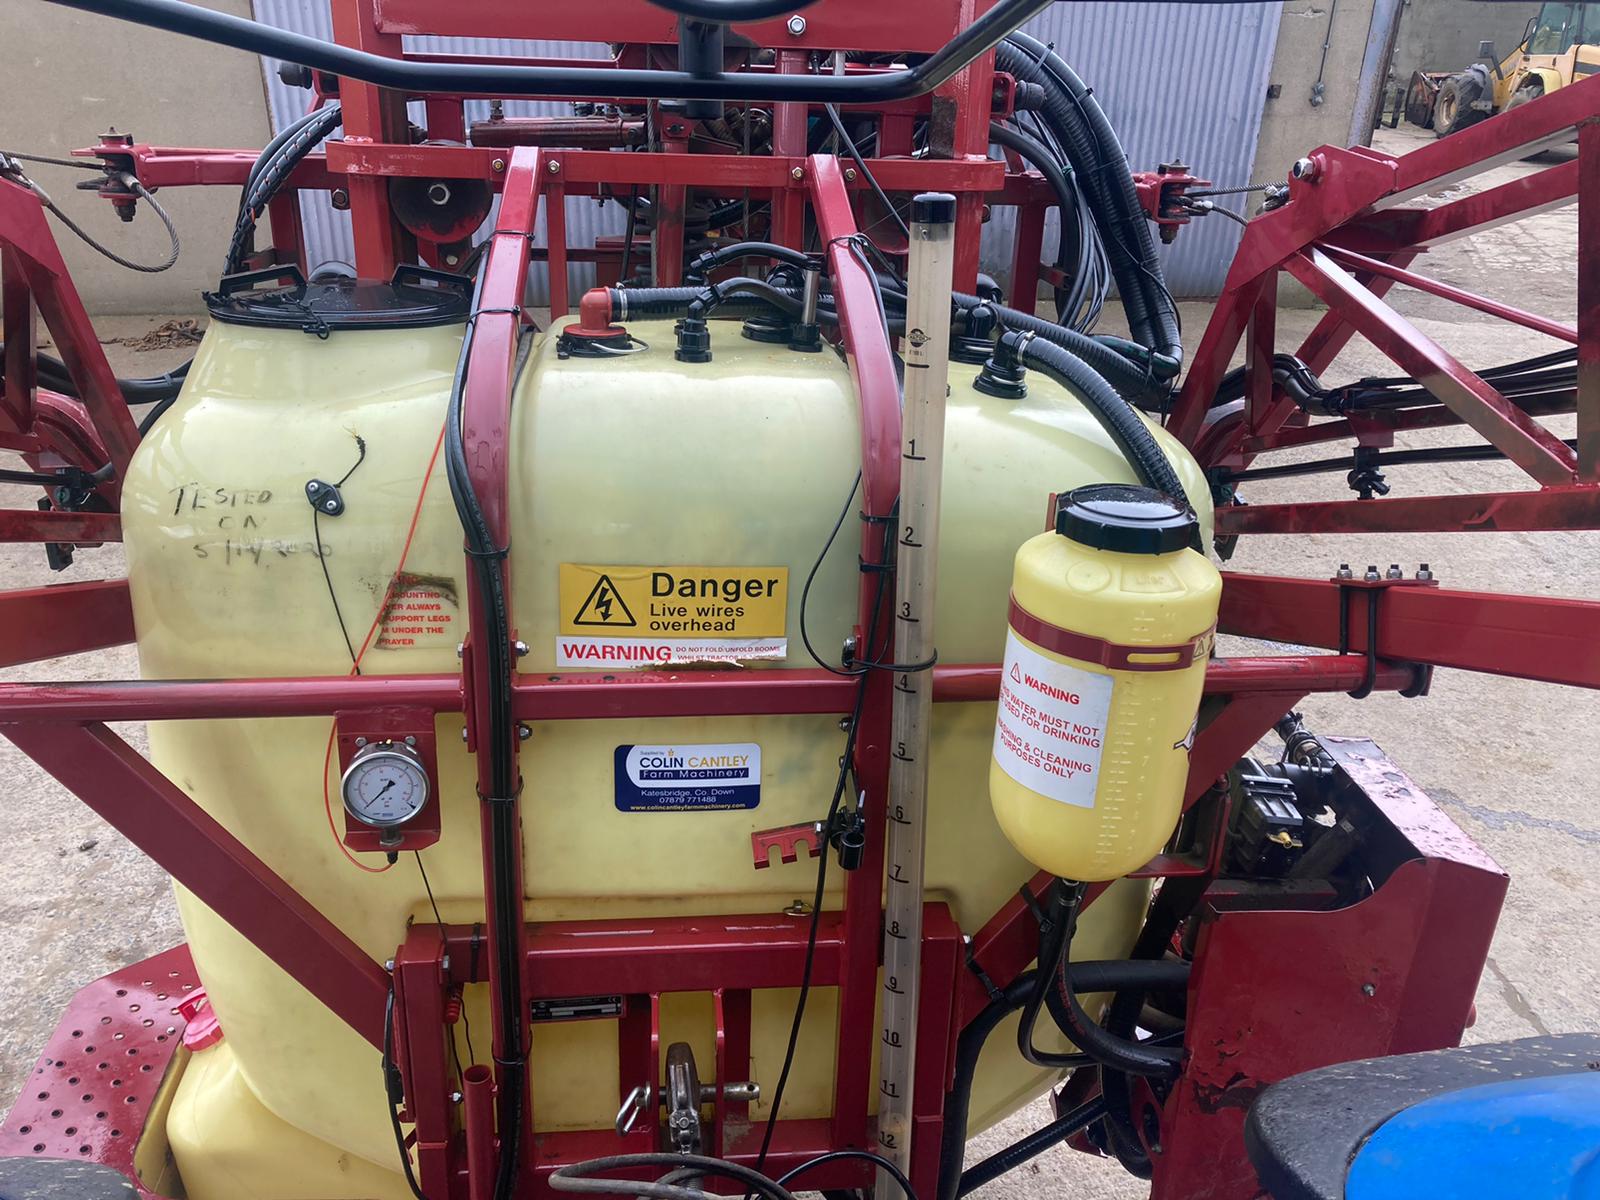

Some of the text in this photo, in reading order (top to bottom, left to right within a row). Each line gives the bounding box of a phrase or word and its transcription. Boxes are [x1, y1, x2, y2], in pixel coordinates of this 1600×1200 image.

[908, 438, 915, 455] 1
[905, 526, 913, 542] 2
[651, 572, 779, 603] Danger
[650, 603, 745, 617] Live wires
[902, 602, 910, 617] 3
[650, 619, 735, 631] overhead
[562, 643, 672, 661] WARNING
[900, 674, 908, 688] 4
[1024, 673, 1080, 705] WARNING
[1010, 693, 1036, 718] WATER
[1039, 711, 1070, 730] MUST
[1073, 724, 1100, 737] NOT
[1021, 713, 1041, 730] FOR
[1043, 725, 1100, 749] DRINKING
[898, 742, 905, 756] 5
[1001, 733, 1075, 779] PURPOSES ONLY
[640, 755, 749, 768] COLIN CANTLEY
[1024, 742, 1031, 752] &
[1033, 747, 1092, 773] CLEANING
[643, 769, 745, 779] Farm Machinery
[711, 788, 735, 796] Down
[895, 805, 903, 820] 6
[894, 864, 902, 878] 7
[891, 921, 899, 935] 8
[889, 976, 897, 989] 9
[884, 1029, 899, 1043] 10
[882, 1079, 896, 1095] 11
[880, 1131, 895, 1146] 12
